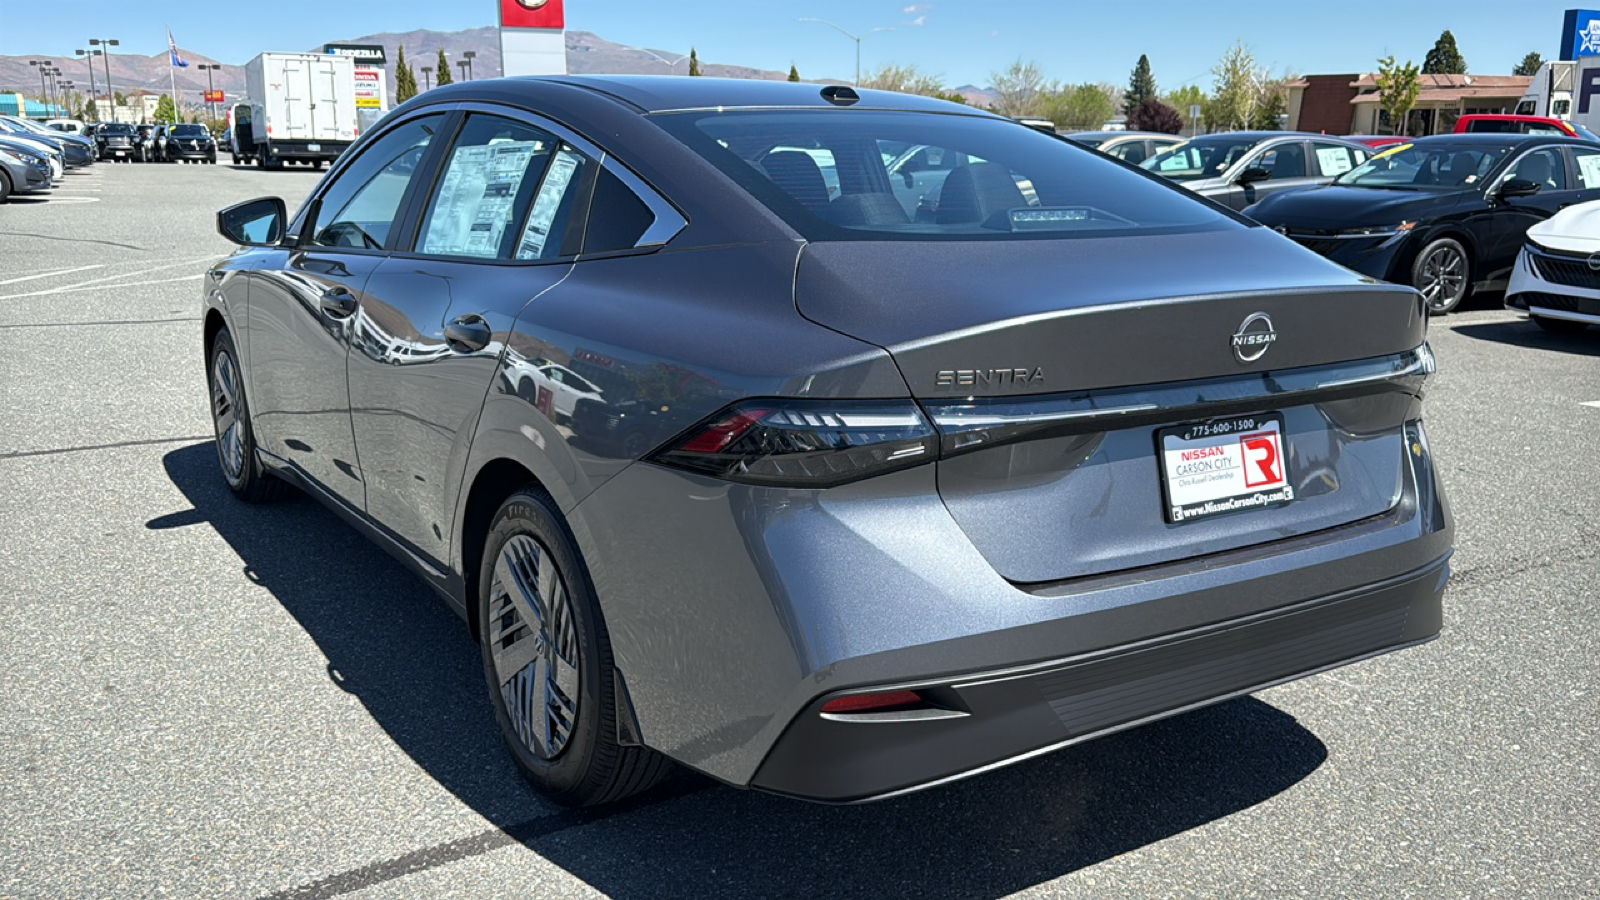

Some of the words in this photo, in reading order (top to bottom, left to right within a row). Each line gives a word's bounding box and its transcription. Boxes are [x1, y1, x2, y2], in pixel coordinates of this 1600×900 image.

[1233, 334, 1277, 346] NISSAN
[935, 367, 1045, 386] SENTRA
[1192, 419, 1255, 436] 775-600-1500
[1181, 446, 1225, 461] NISSAN
[1176, 460, 1212, 475] CARSON
[1214, 456, 1232, 469] CITY
[1183, 492, 1285, 517] www.NissanCarsonCity.com
